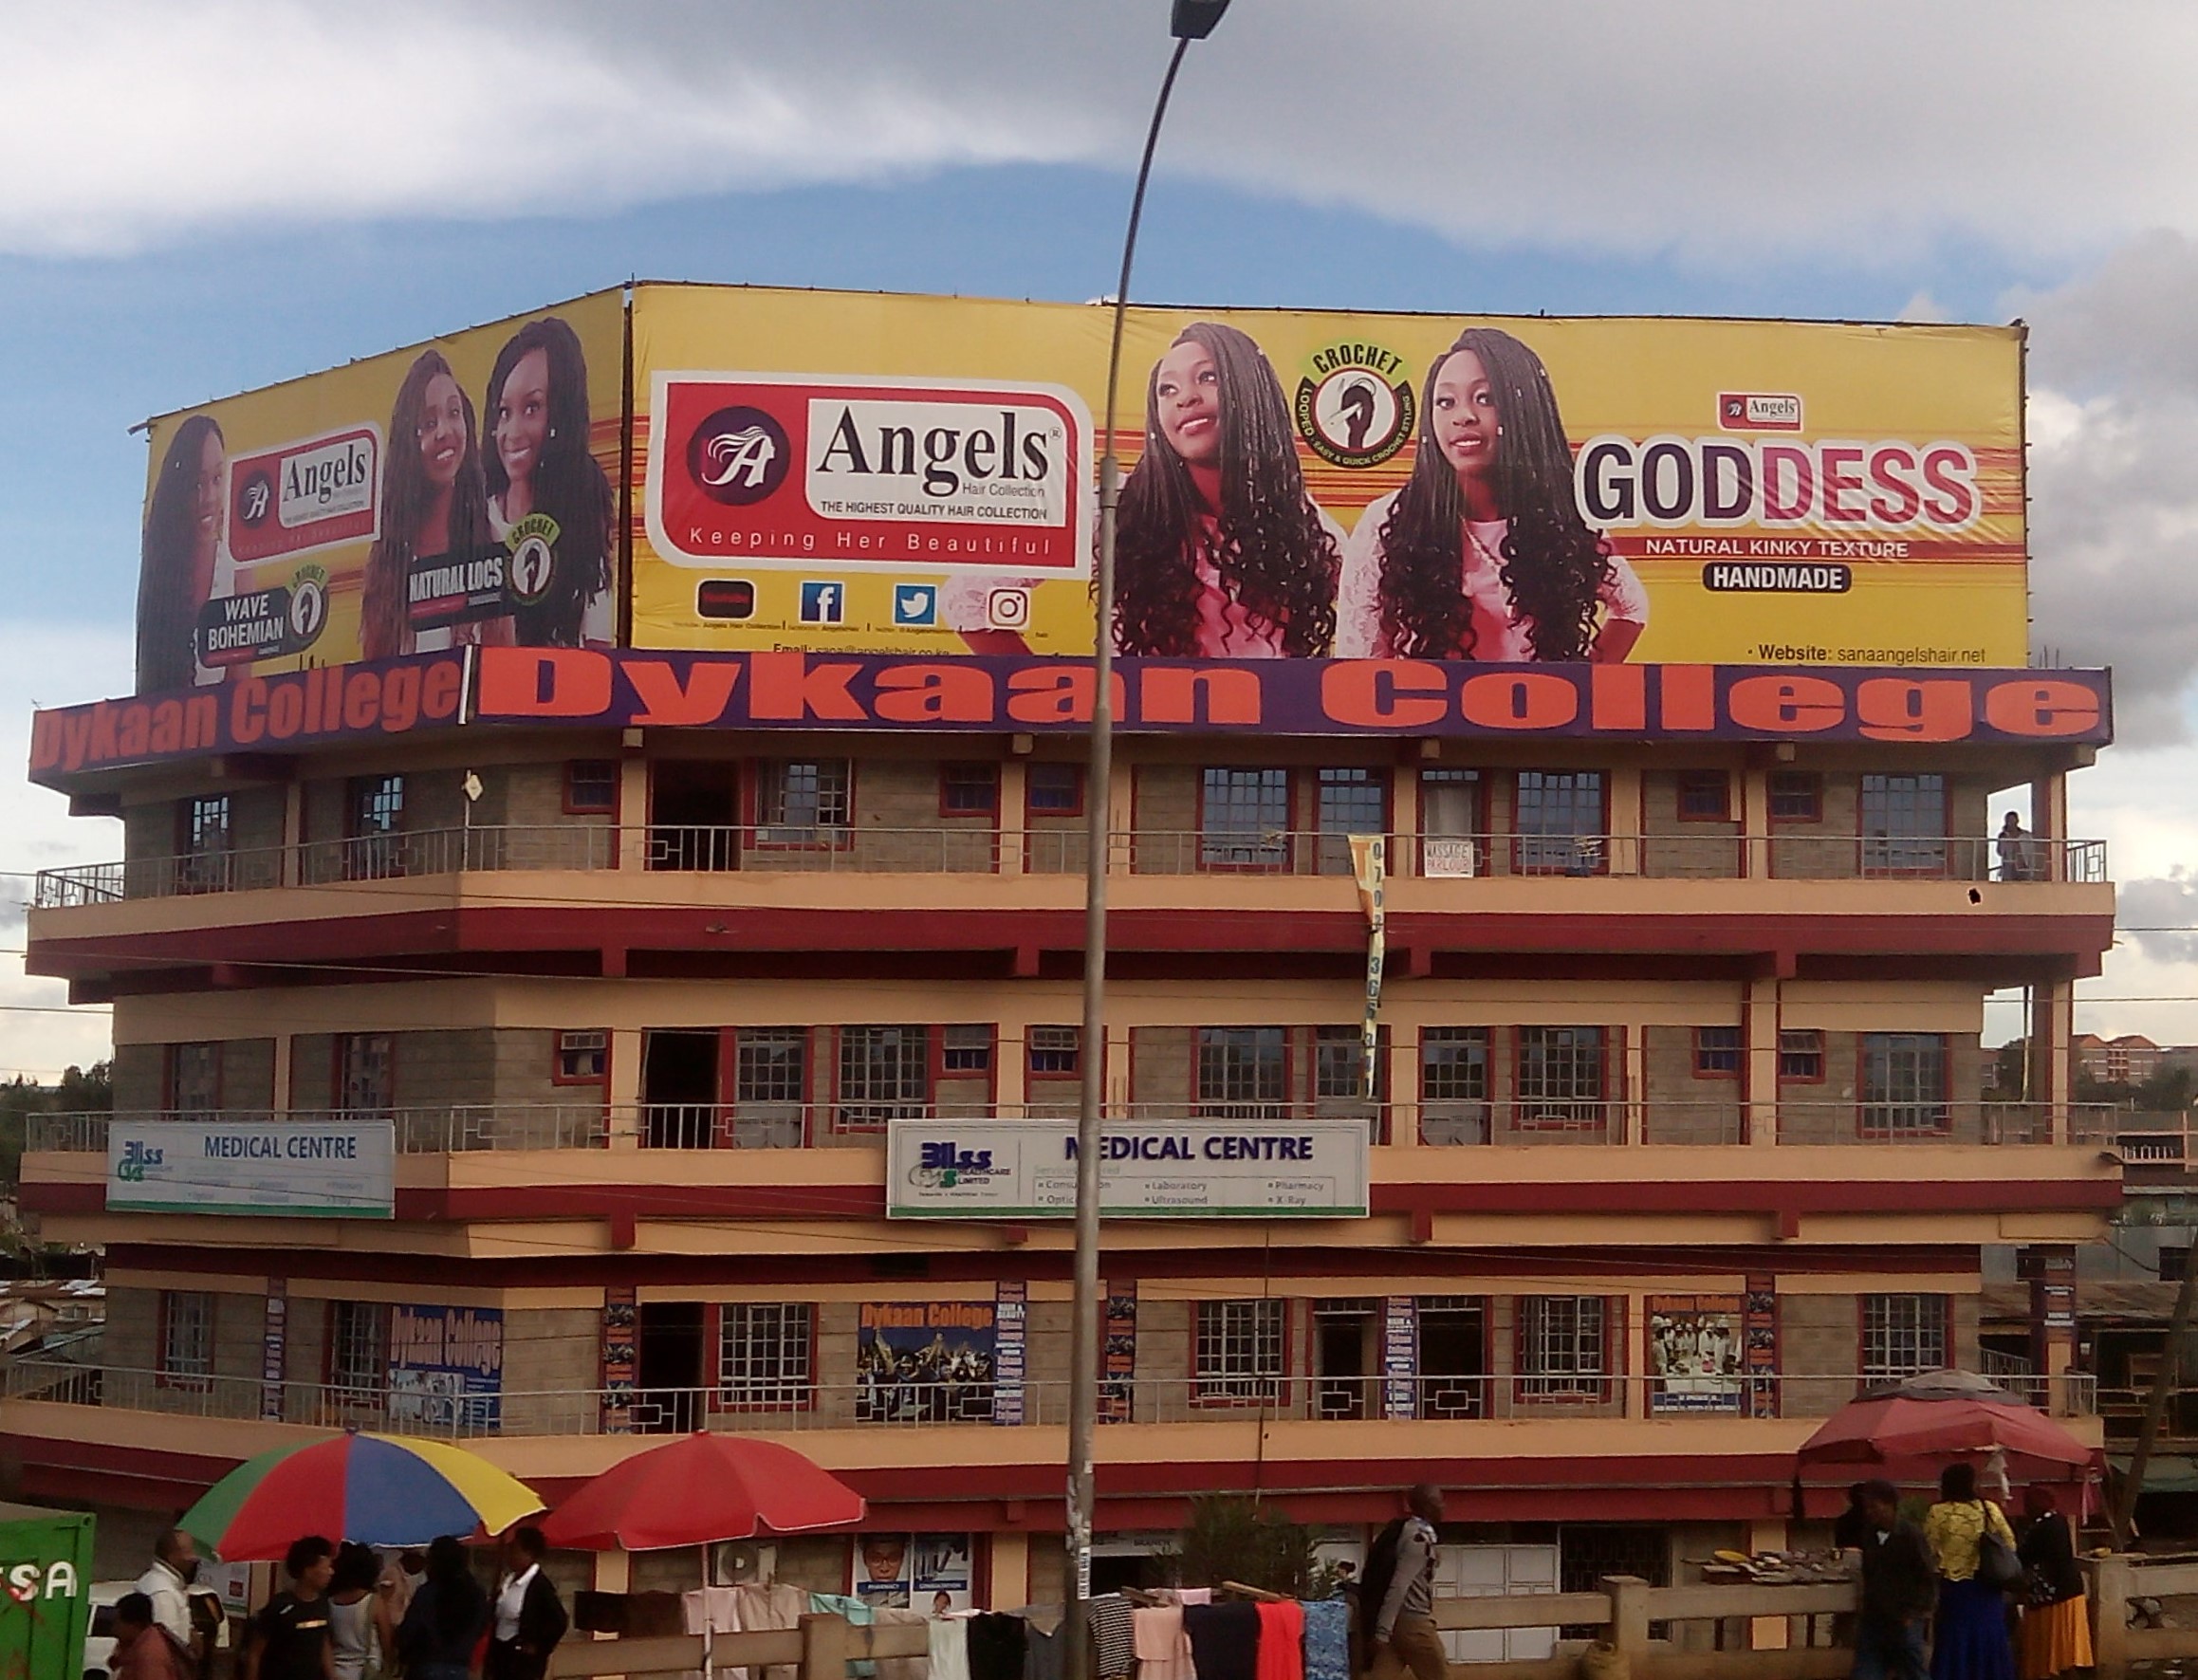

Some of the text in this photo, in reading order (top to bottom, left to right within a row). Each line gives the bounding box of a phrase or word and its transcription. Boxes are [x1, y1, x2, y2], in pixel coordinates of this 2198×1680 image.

[1313, 343, 1403, 375] CROCHET
[1299, 387, 1315, 436] LOOPED
[1750, 399, 1795, 417] Angels
[816, 405, 1049, 497] Angels
[1342, 456, 1372, 465] QUICK
[1372, 434, 1405, 462] CROCHET
[283, 444, 366, 504] Angels
[1583, 442, 1973, 526] GODDESS
[962, 483, 1045, 499] Hair Collection
[821, 501, 1047, 520] THE HIGHEST QUALITY HAIR COLLECTION
[690, 527, 1049, 555] Keeping Her Beautiful
[1646, 539, 1910, 558] NATURAL KINKY TEXTURE
[409, 564, 466, 602] NATURAL
[468, 557, 504, 591] LOCS
[1713, 566, 1843, 590] HANDMADE
[225, 594, 268, 621] WAVE
[209, 617, 284, 651] BOHEMIAN
[1759, 644, 1986, 666] Website: sanaangelshair.net
[478, 647, 2099, 743] Dykaan College
[32, 660, 460, 772] Dykaan College
[204, 1135, 357, 1159] MEDICAL CENTRE
[1065, 1136, 1313, 1160] MEDICAL CENTRE
[1046, 1180, 1111, 1189] Consuon
[1152, 1181, 1207, 1191] Laboratory
[1275, 1181, 1324, 1191] Pharmacy
[1152, 1195, 1208, 1205] Ultrasound
[861, 1302, 993, 1330] Dykaan College
[446, 1308, 501, 1376] College
[0, 1560, 78, 1601] SA
